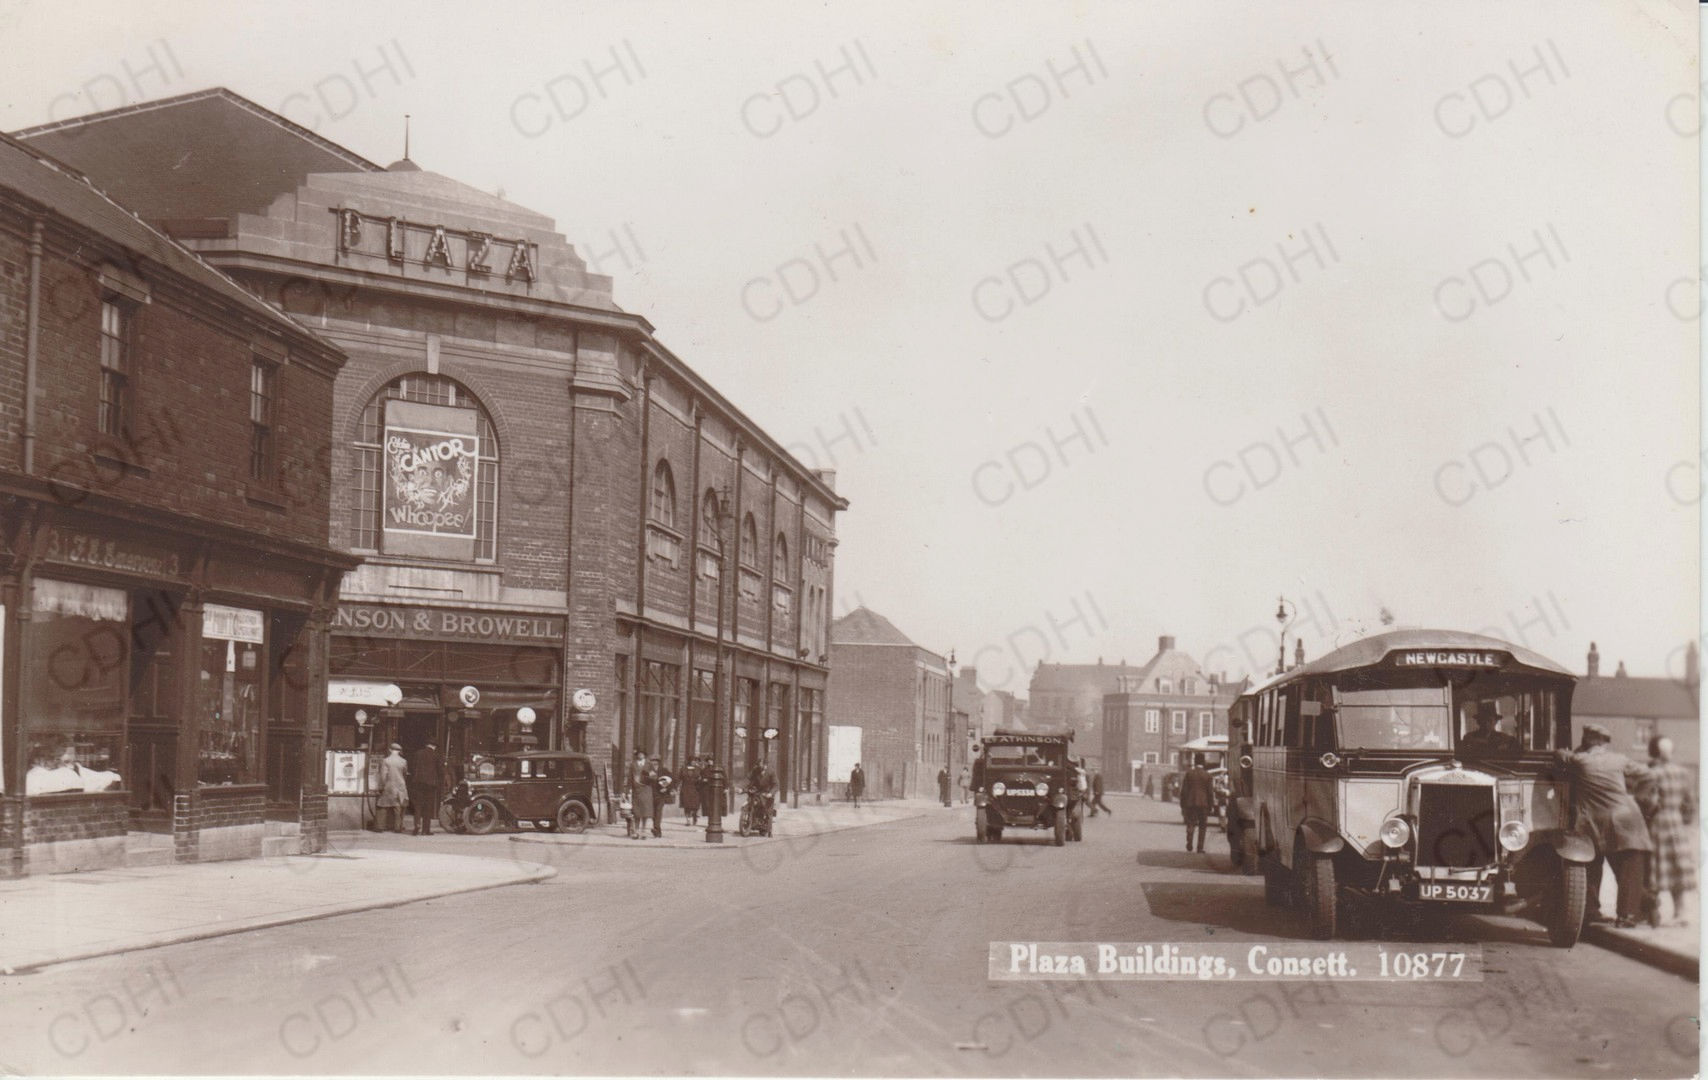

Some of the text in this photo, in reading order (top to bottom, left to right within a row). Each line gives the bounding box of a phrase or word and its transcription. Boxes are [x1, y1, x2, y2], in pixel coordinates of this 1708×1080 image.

[341, 208, 537, 284] PLAZA
[400, 438, 476, 472] CANTOR
[413, 611, 432, 631] &
[1405, 652, 1494, 665] NEWCASTLE
[1420, 884, 1490, 900] UP 5037
